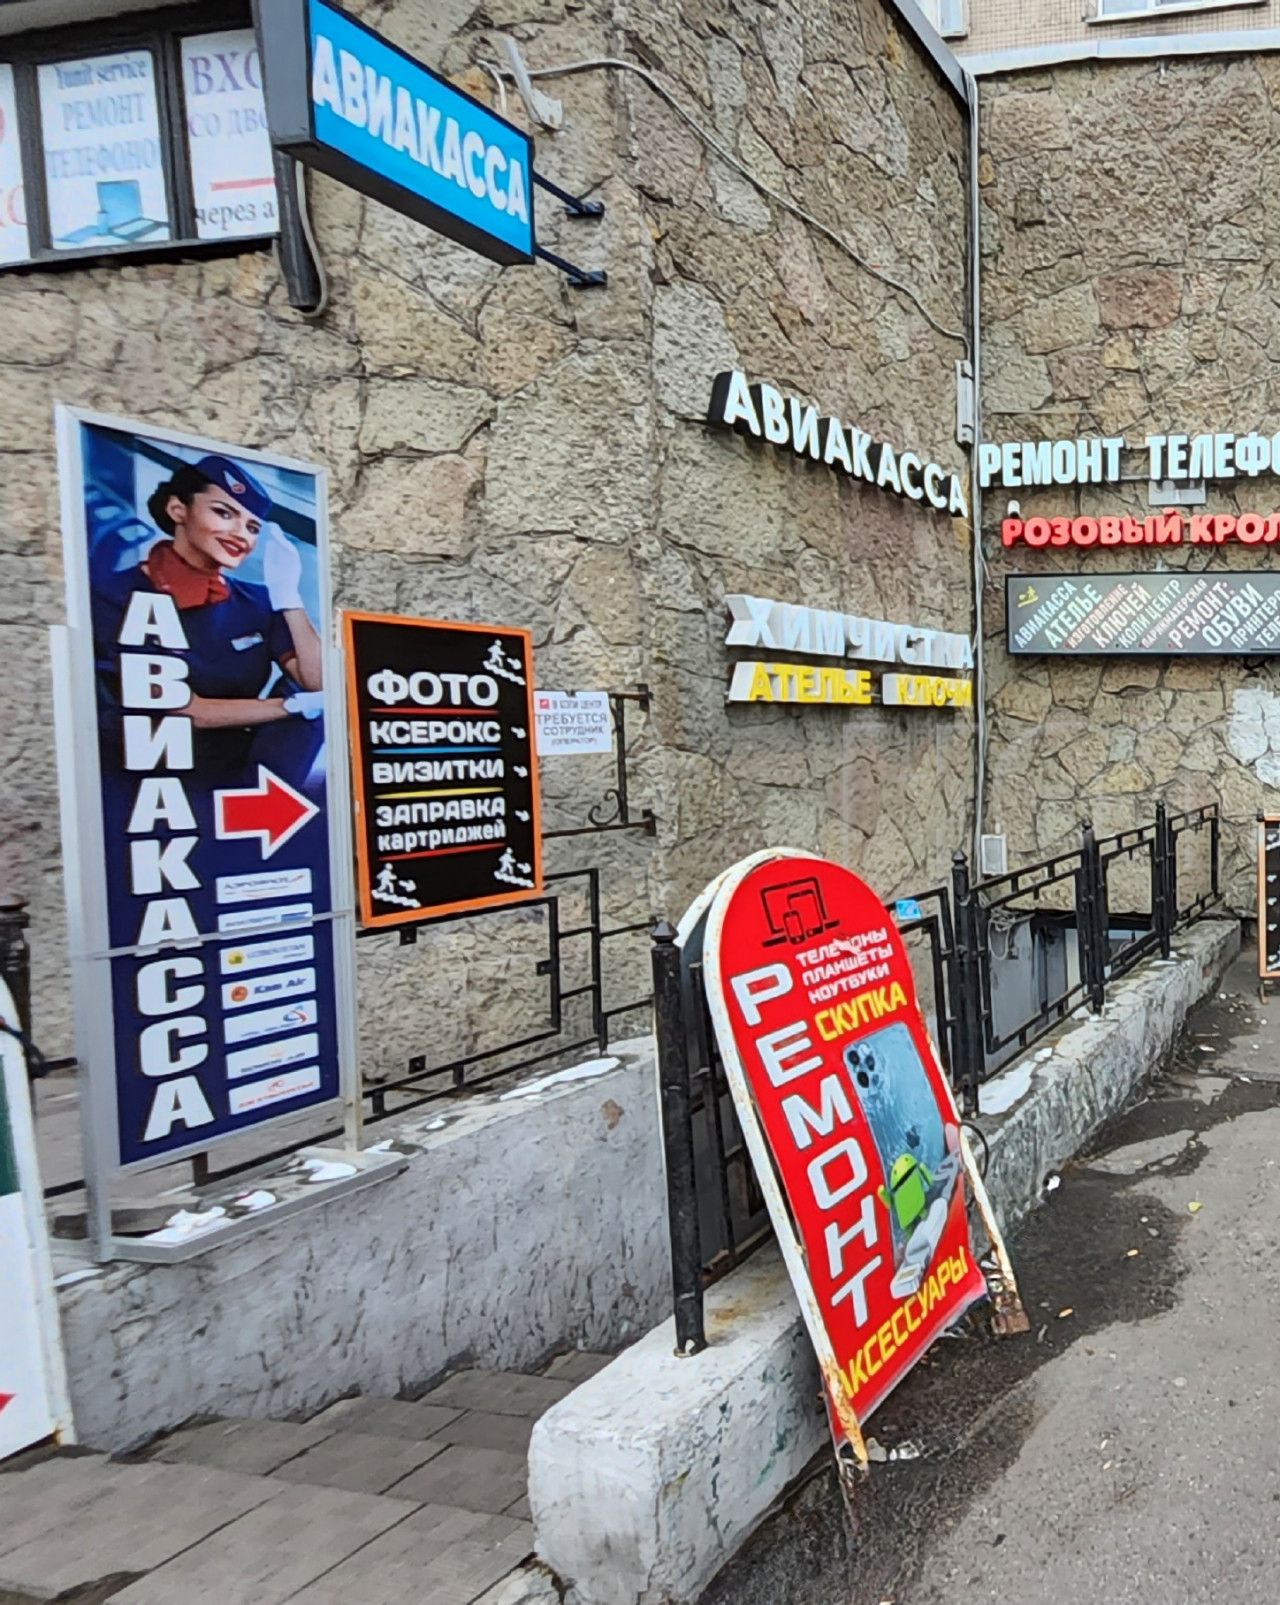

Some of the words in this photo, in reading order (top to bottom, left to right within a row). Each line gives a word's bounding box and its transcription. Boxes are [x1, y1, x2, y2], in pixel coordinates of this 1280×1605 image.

[62, 93, 145, 132] РЕМОНТ
[312, 34, 529, 224] АВИАКАССА
[722, 369, 969, 519] АВИАКАССА
[979, 436, 1125, 488] РЕМОНТ
[1002, 508, 1182, 547] РОЗОВЫЙ
[1014, 580, 1077, 649] АВИАКАССА
[1044, 583, 1102, 649] АТЕЛЬЕ
[1066, 583, 1129, 649] ИЗГОТОВЛЕНИЕ
[1091, 581, 1153, 649] КЛЮЧЕЙ
[1118, 614, 1151, 649] КОПИ
[1145, 578, 1182, 620] ЦЕНТР
[1140, 577, 1209, 649] ПАРИКМАХЕРСКАЯ
[1168, 581, 1235, 649] РЕМОНТ:
[1202, 581, 1265, 648] ОБУВИ
[367, 669, 500, 707] ФОТО
[748, 662, 872, 704] АТЕЛЬЕ
[369, 720, 502, 745] КСЕРОКС
[535, 712, 607, 725] ТРЕБУЕТСЯ
[543, 726, 604, 736] СОТРУДНИК
[372, 759, 504, 785] ВИЗИТКИ
[376, 797, 506, 827] ЗАПРАВКА
[377, 818, 507, 852] картриджей
[117, 590, 216, 1143] АВИАКАССА
[795, 927, 888, 968] ТЕЛЕОНЫ
[802, 943, 894, 986] ПЛАНШЕТЫ
[808, 962, 890, 1004] НОУТБУКИ
[815, 981, 908, 1042] СКУПКА
[731, 962, 883, 1329] РЕМОНТ
